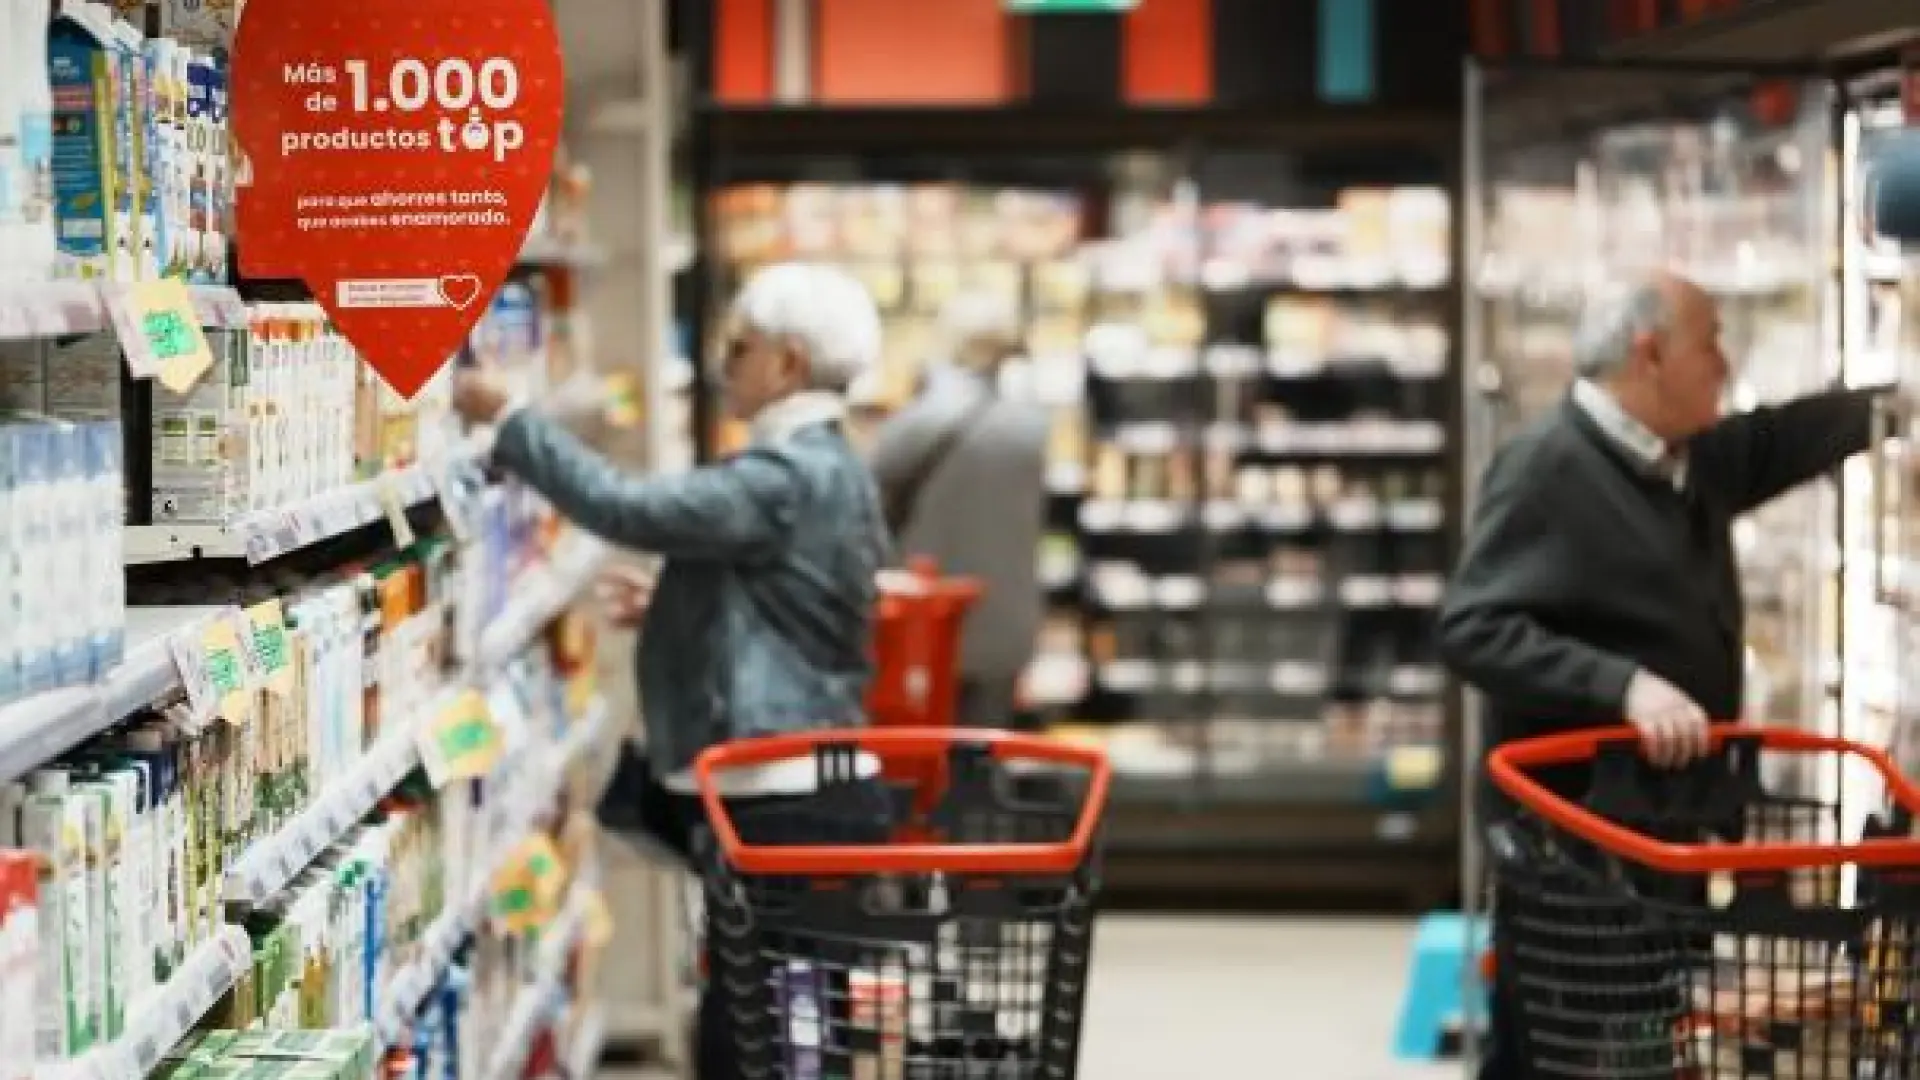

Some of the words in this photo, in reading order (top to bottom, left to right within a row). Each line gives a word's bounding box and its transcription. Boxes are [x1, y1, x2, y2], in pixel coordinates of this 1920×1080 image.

[284, 62, 337, 83] Más
[345, 57, 518, 112] 1.000
[305, 92, 337, 112] de
[281, 127, 431, 156] productos
[370, 189, 448, 207] ahorres
[450, 189, 508, 207] tanto,
[297, 216, 327, 231] que
[389, 208, 511, 227] enamorado.
